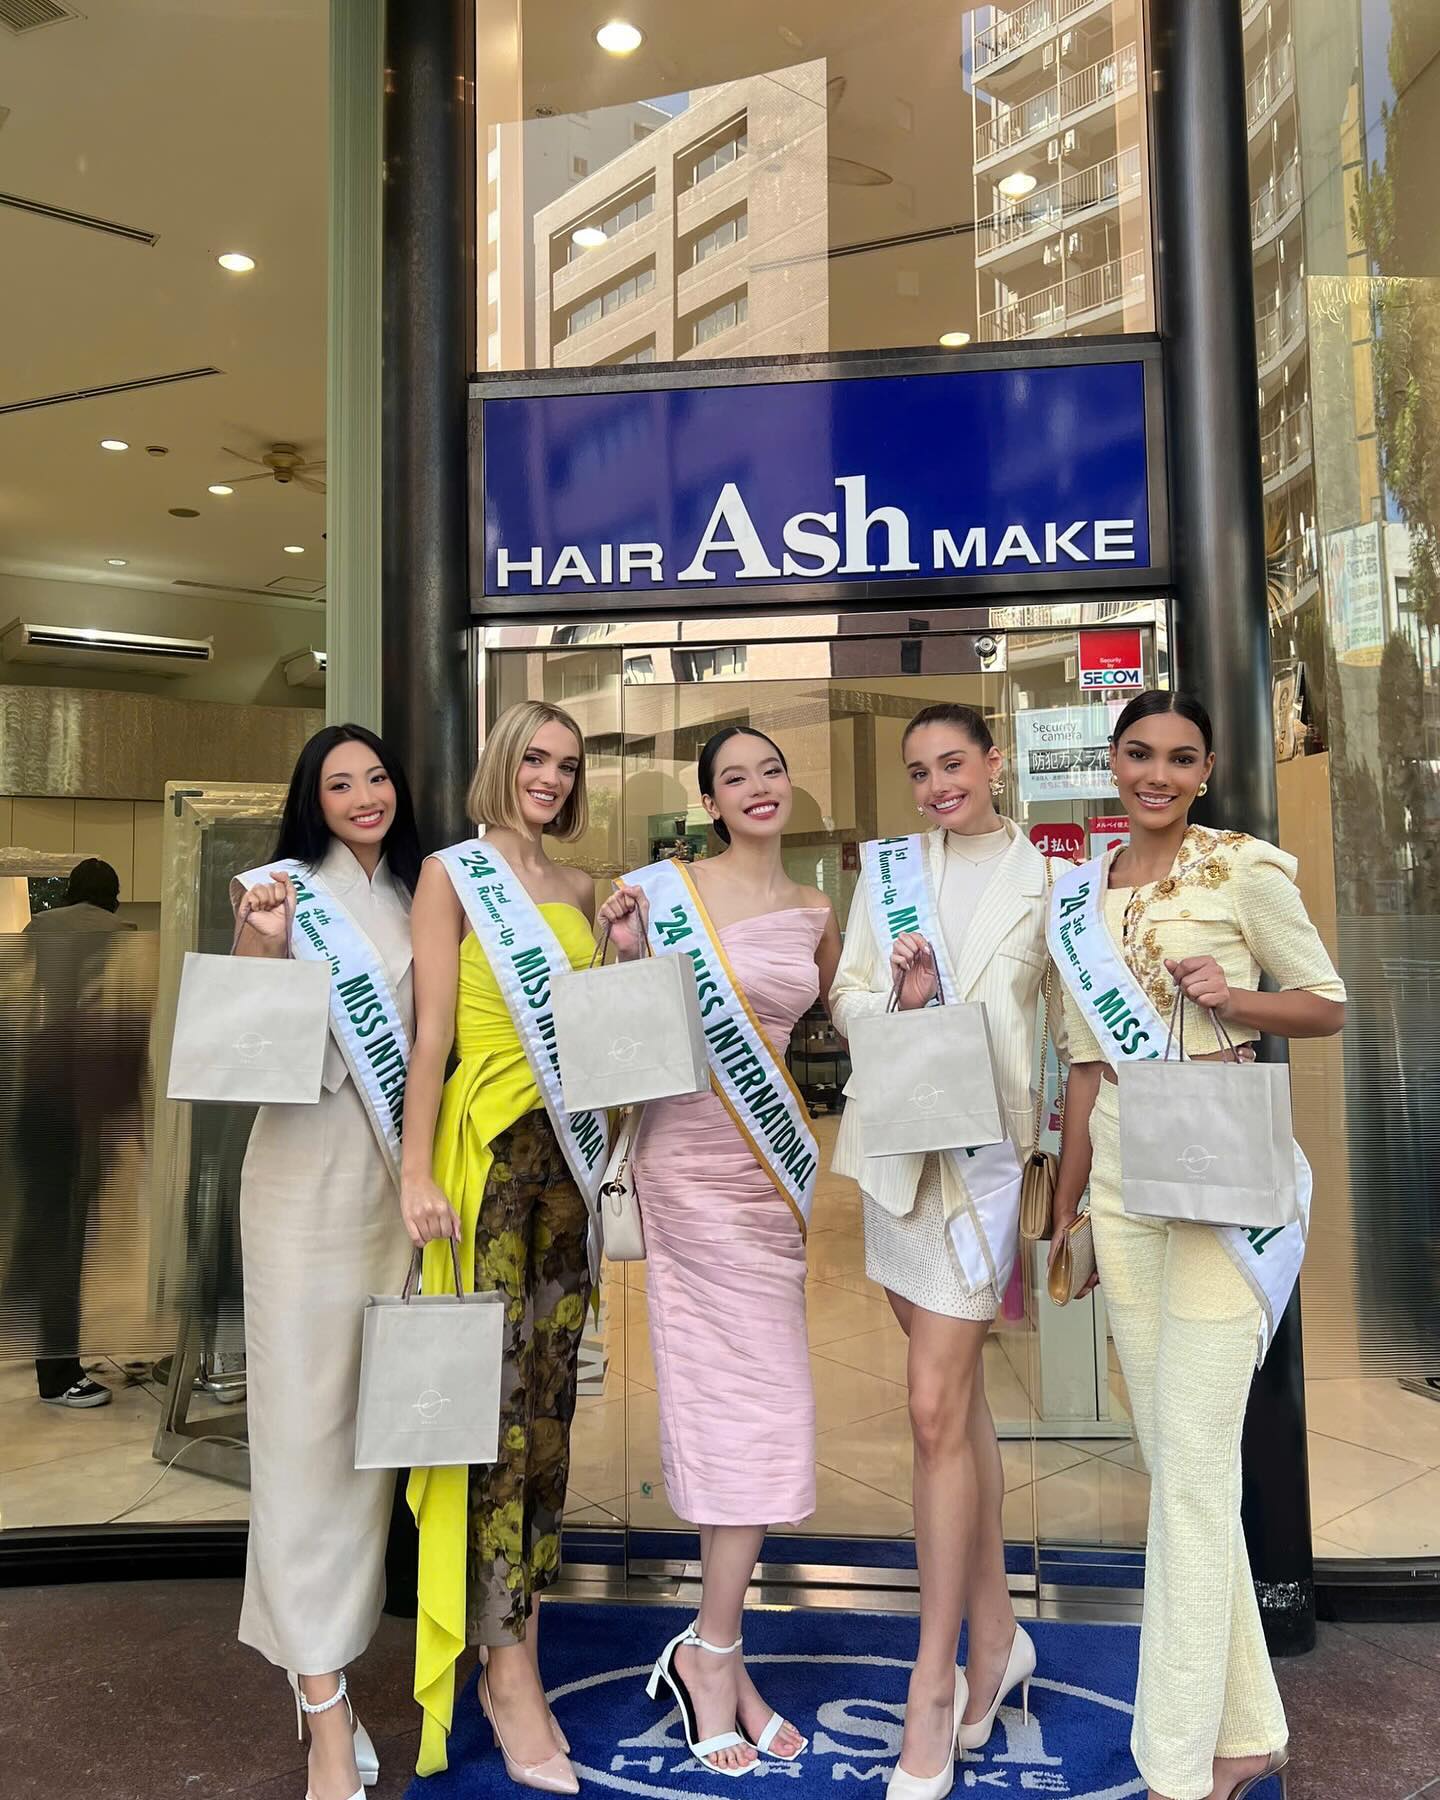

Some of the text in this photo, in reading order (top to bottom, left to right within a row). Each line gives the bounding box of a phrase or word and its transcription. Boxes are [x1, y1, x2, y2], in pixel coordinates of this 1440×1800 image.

[496, 474, 1136, 588] HAIR Ash MAKE
[1099, 656, 1121, 664] Security
[1083, 670, 1139, 685] SECOM
[1032, 722, 1077, 733] Security
[1041, 731, 1082, 742] camera
[458, 850, 496, 878] '24
[895, 847, 908, 861] 1st
[491, 883, 512, 904] 2nd
[879, 849, 897, 906] Runner-Up
[313, 908, 332, 925] 4th
[477, 885, 515, 946] Runner-Up
[1059, 881, 1090, 919] '24
[654, 904, 693, 947] '24
[1073, 914, 1086, 936] 3rd
[1059, 921, 1093, 992] Runner-Up
[511, 946, 551, 1009] MISS
[336, 972, 388, 1038] MISS
[1093, 986, 1150, 1055] MISS
[704, 1016, 816, 1192] INTERNATIONAL
[832, 1763, 1071, 1791] MKE
